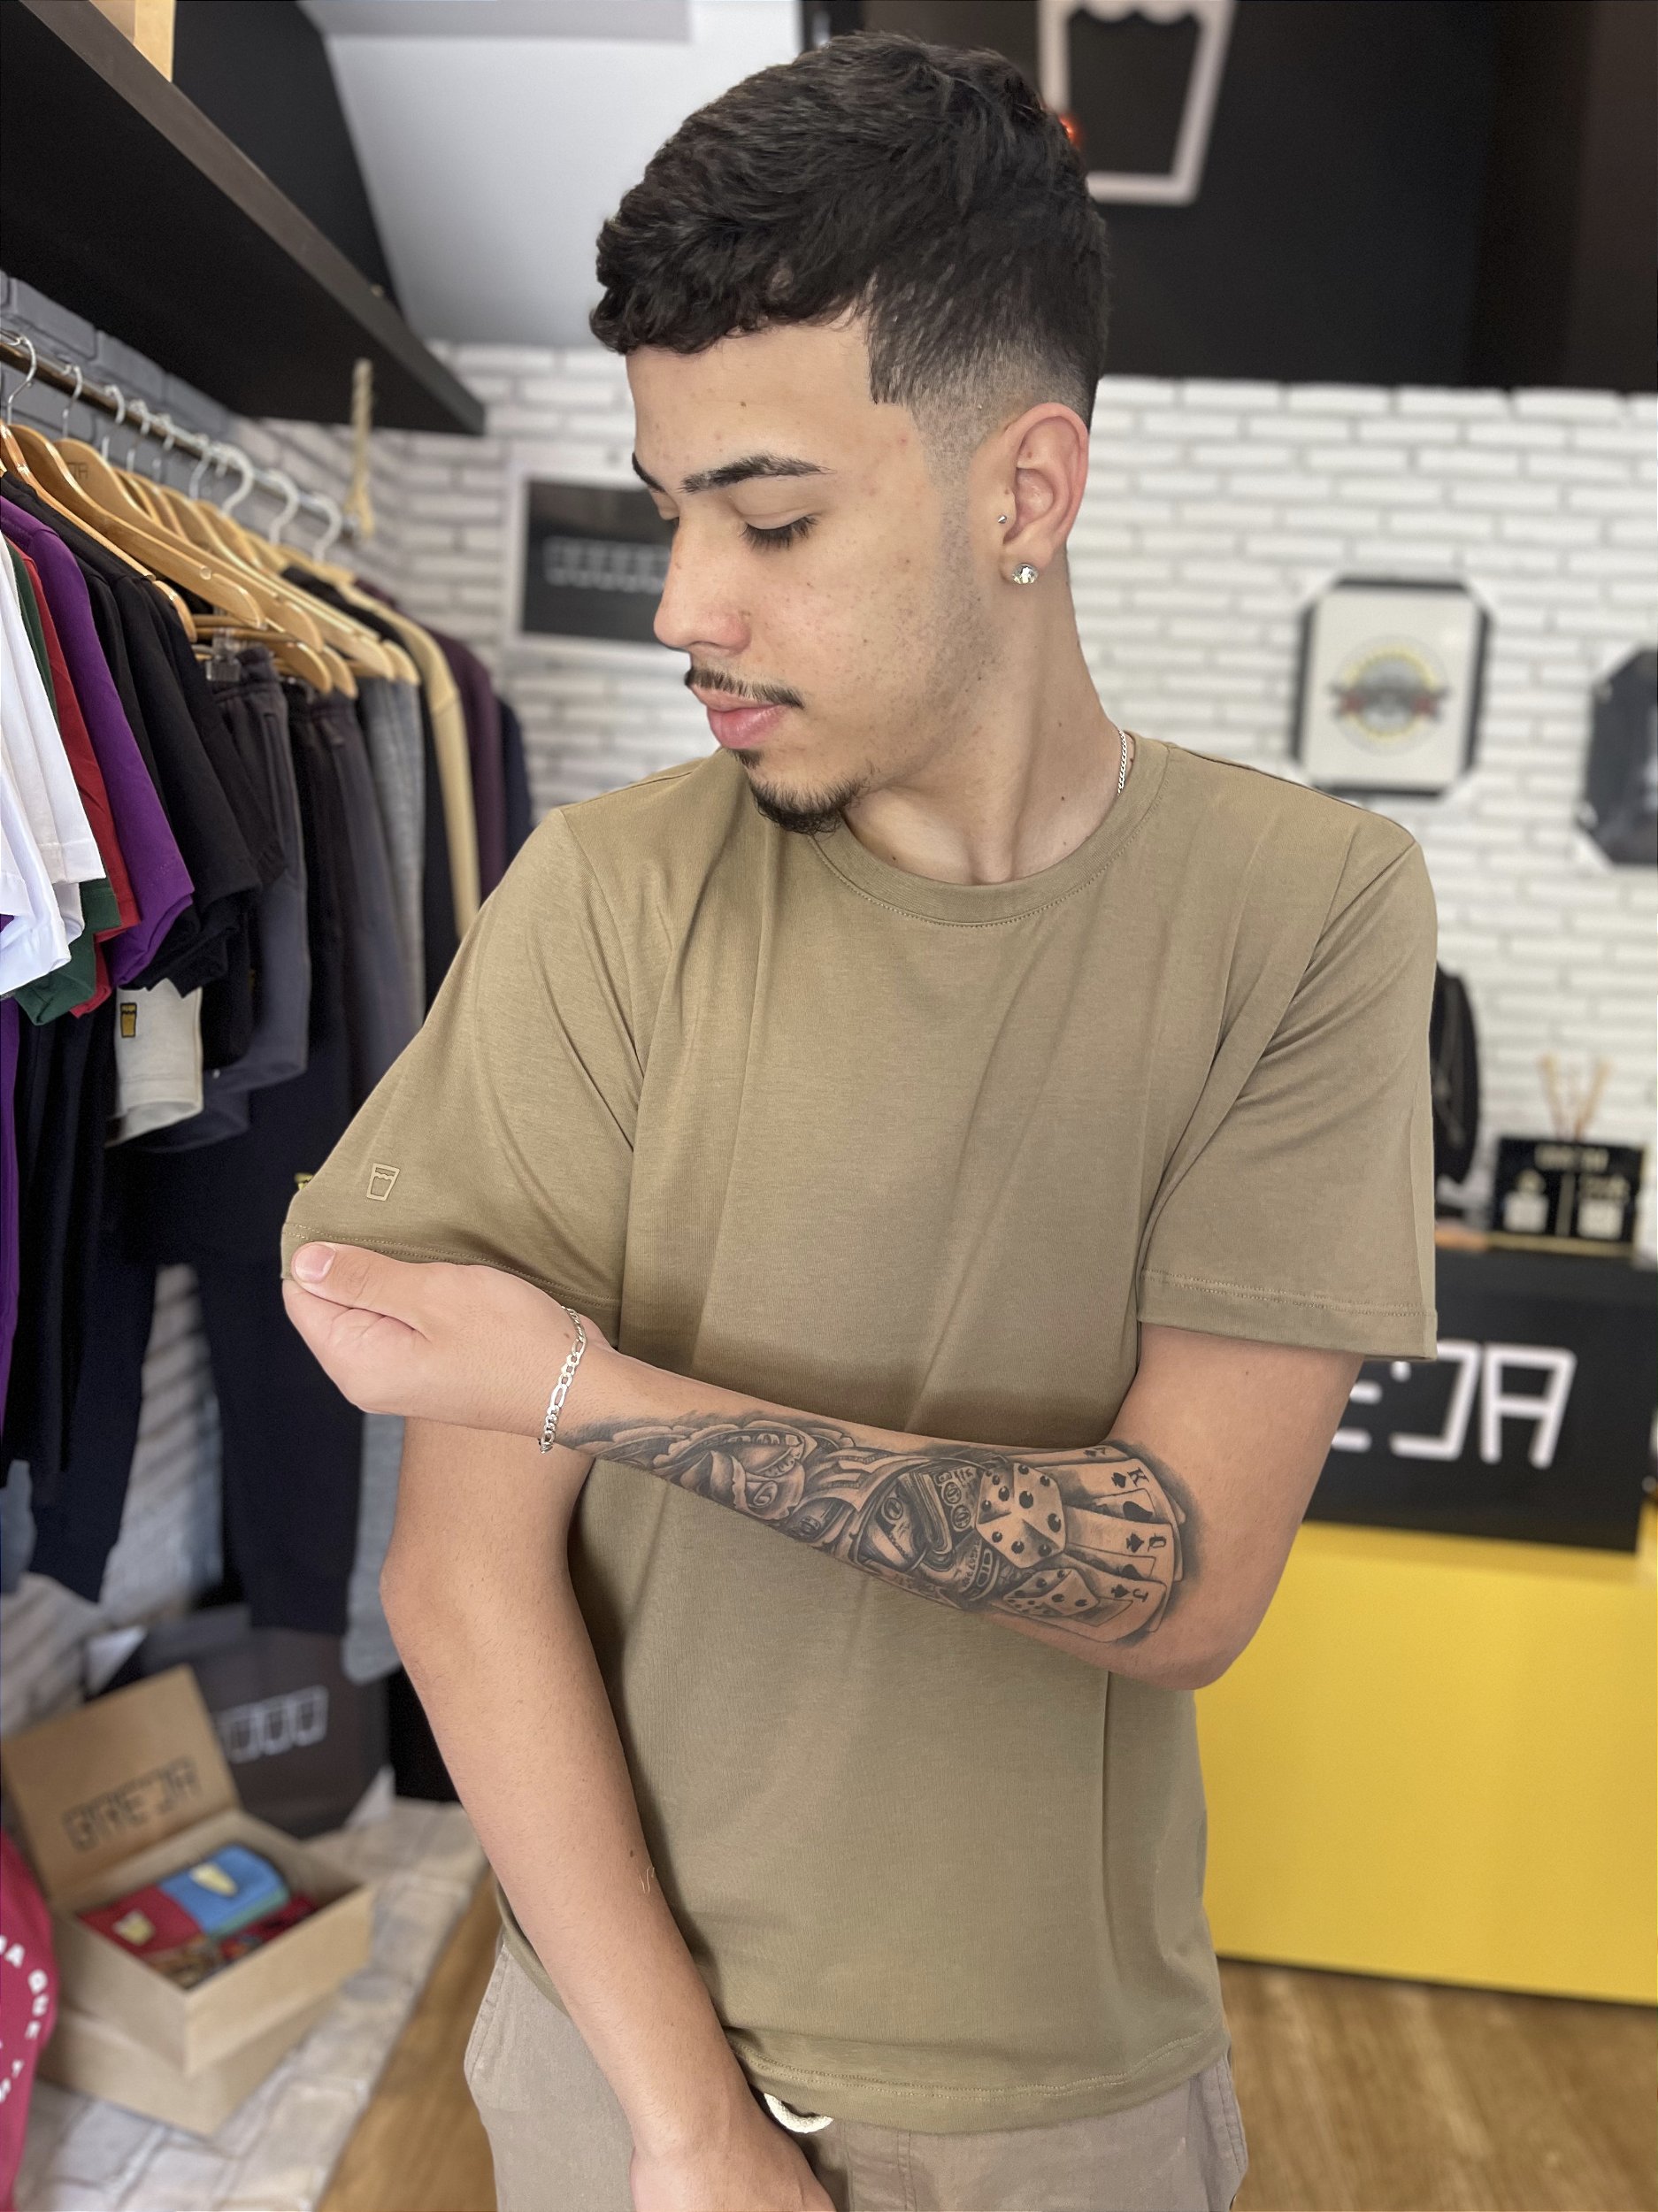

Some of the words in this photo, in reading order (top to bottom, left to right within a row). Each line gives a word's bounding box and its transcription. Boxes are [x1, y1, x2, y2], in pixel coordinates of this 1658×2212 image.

[1127, 1467, 1150, 1487] K
[1148, 1532, 1167, 1552] Q
[1132, 1588, 1149, 1603] J
